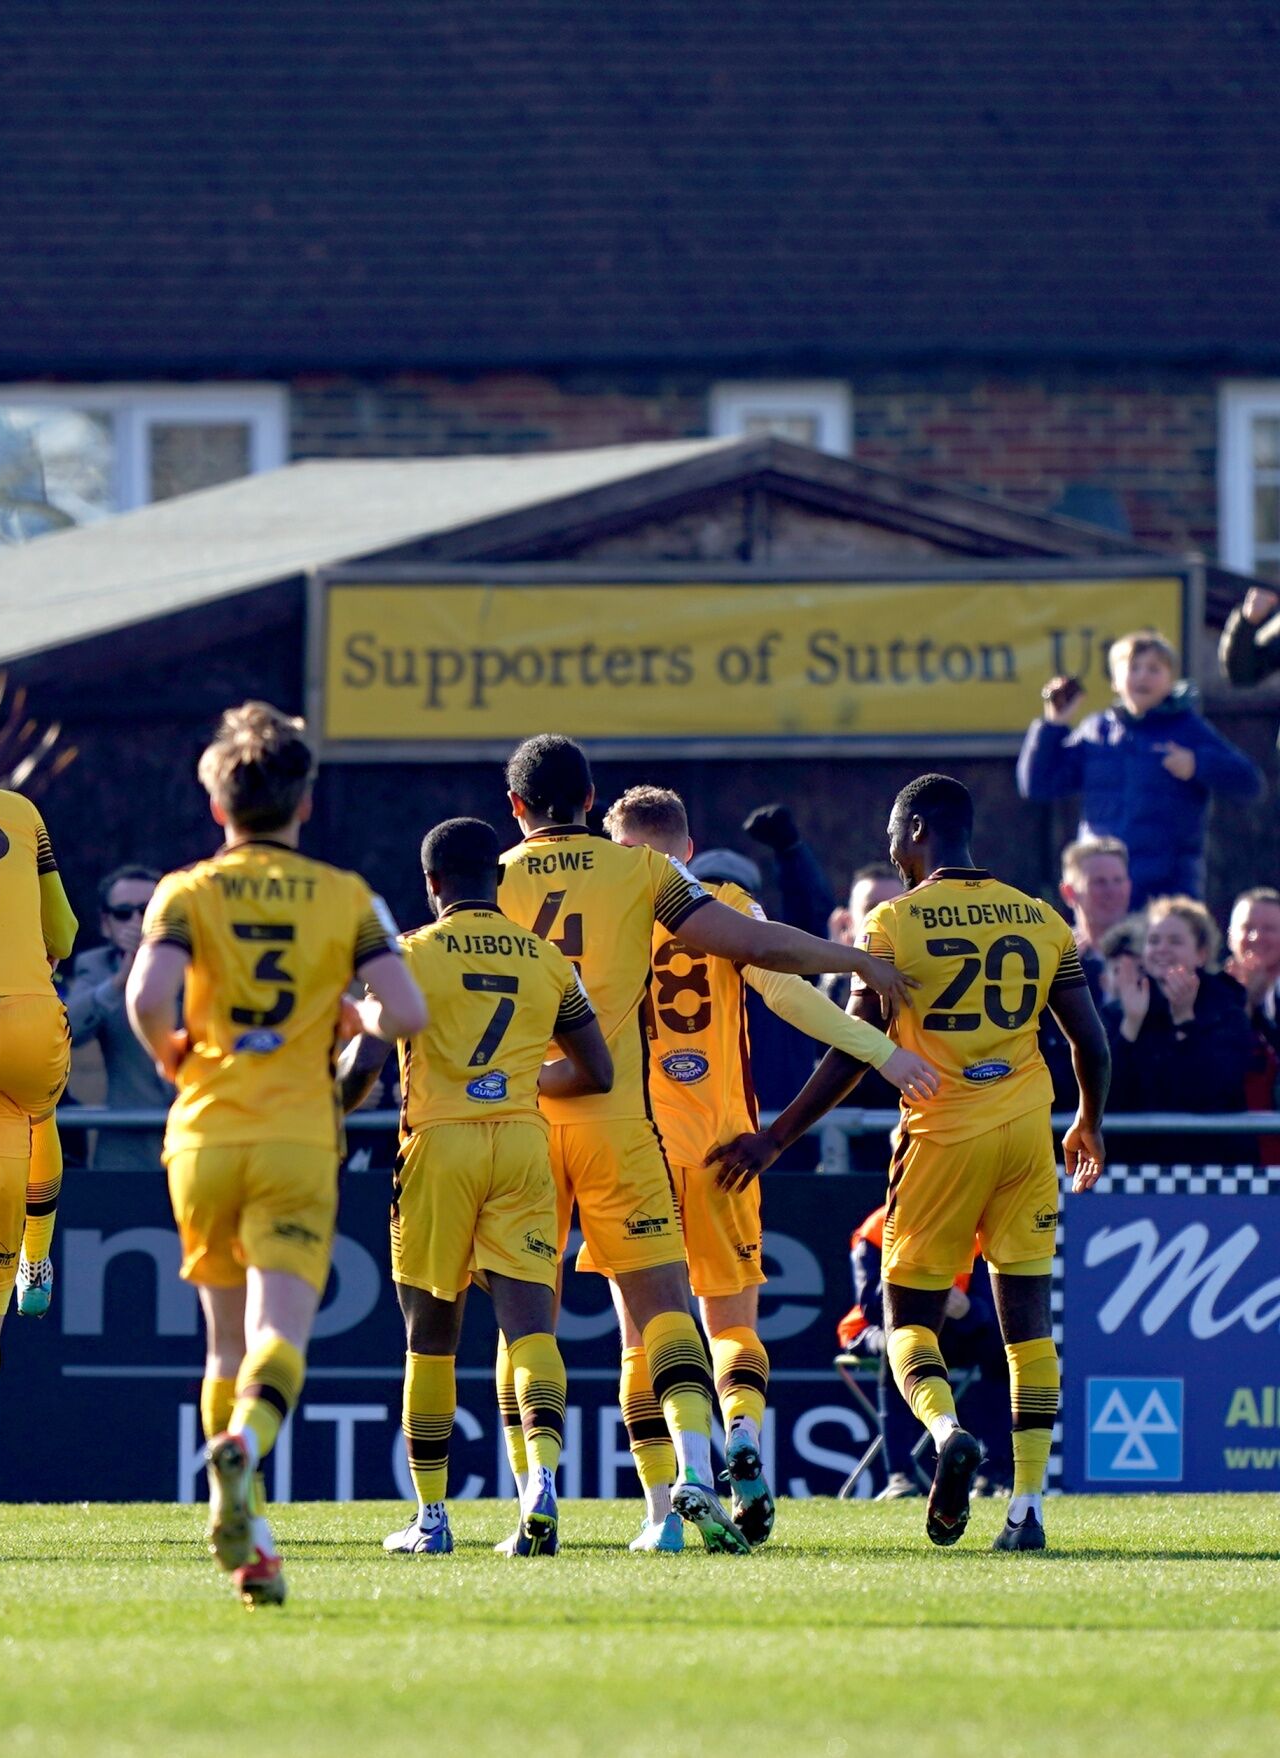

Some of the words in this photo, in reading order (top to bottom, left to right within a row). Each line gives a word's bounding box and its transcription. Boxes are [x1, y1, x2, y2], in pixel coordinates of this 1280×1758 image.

[342, 631, 694, 709] Supporters
[715, 629, 783, 686] of
[805, 628, 1016, 686] Sutton
[222, 876, 316, 900] WYATT
[527, 850, 595, 875] ROWE
[446, 934, 540, 959] AJIBOYE
[531, 890, 583, 976] 4
[922, 902, 1046, 929] BOLDEWIJN
[231, 924, 296, 1027] 3
[923, 935, 1039, 1031] 20
[462, 973, 518, 1067] 7
